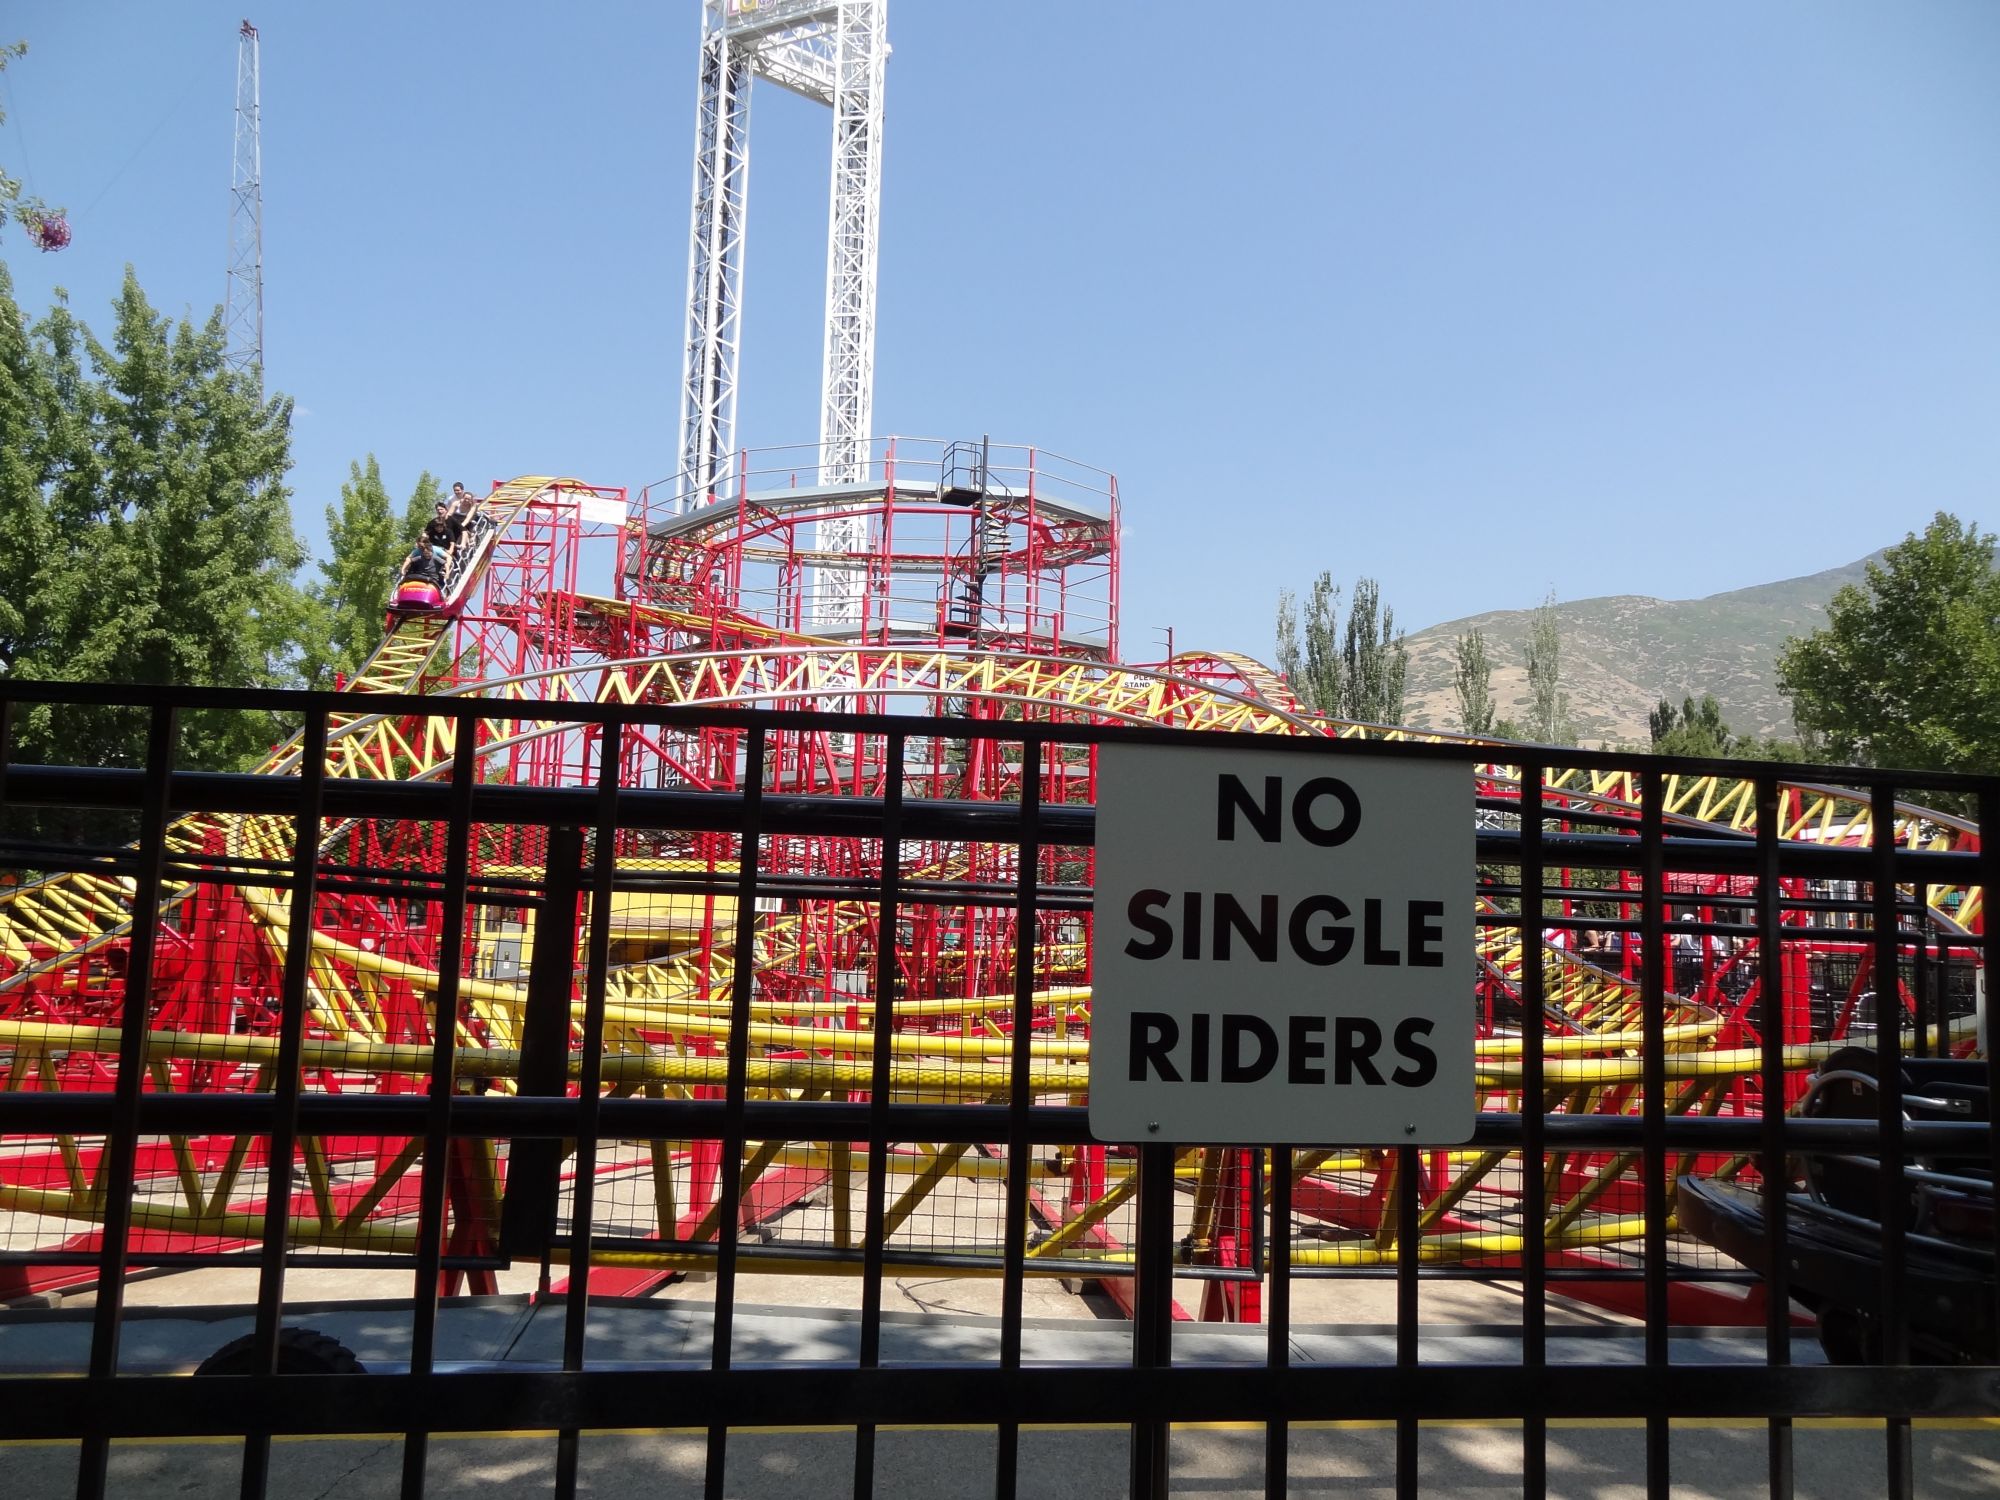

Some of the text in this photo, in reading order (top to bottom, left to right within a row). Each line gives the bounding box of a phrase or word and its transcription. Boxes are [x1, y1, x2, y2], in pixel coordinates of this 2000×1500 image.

[1217, 773, 1362, 848] NO
[1123, 888, 1445, 968] SINGLE
[1128, 1011, 1438, 1088] RIDERS
